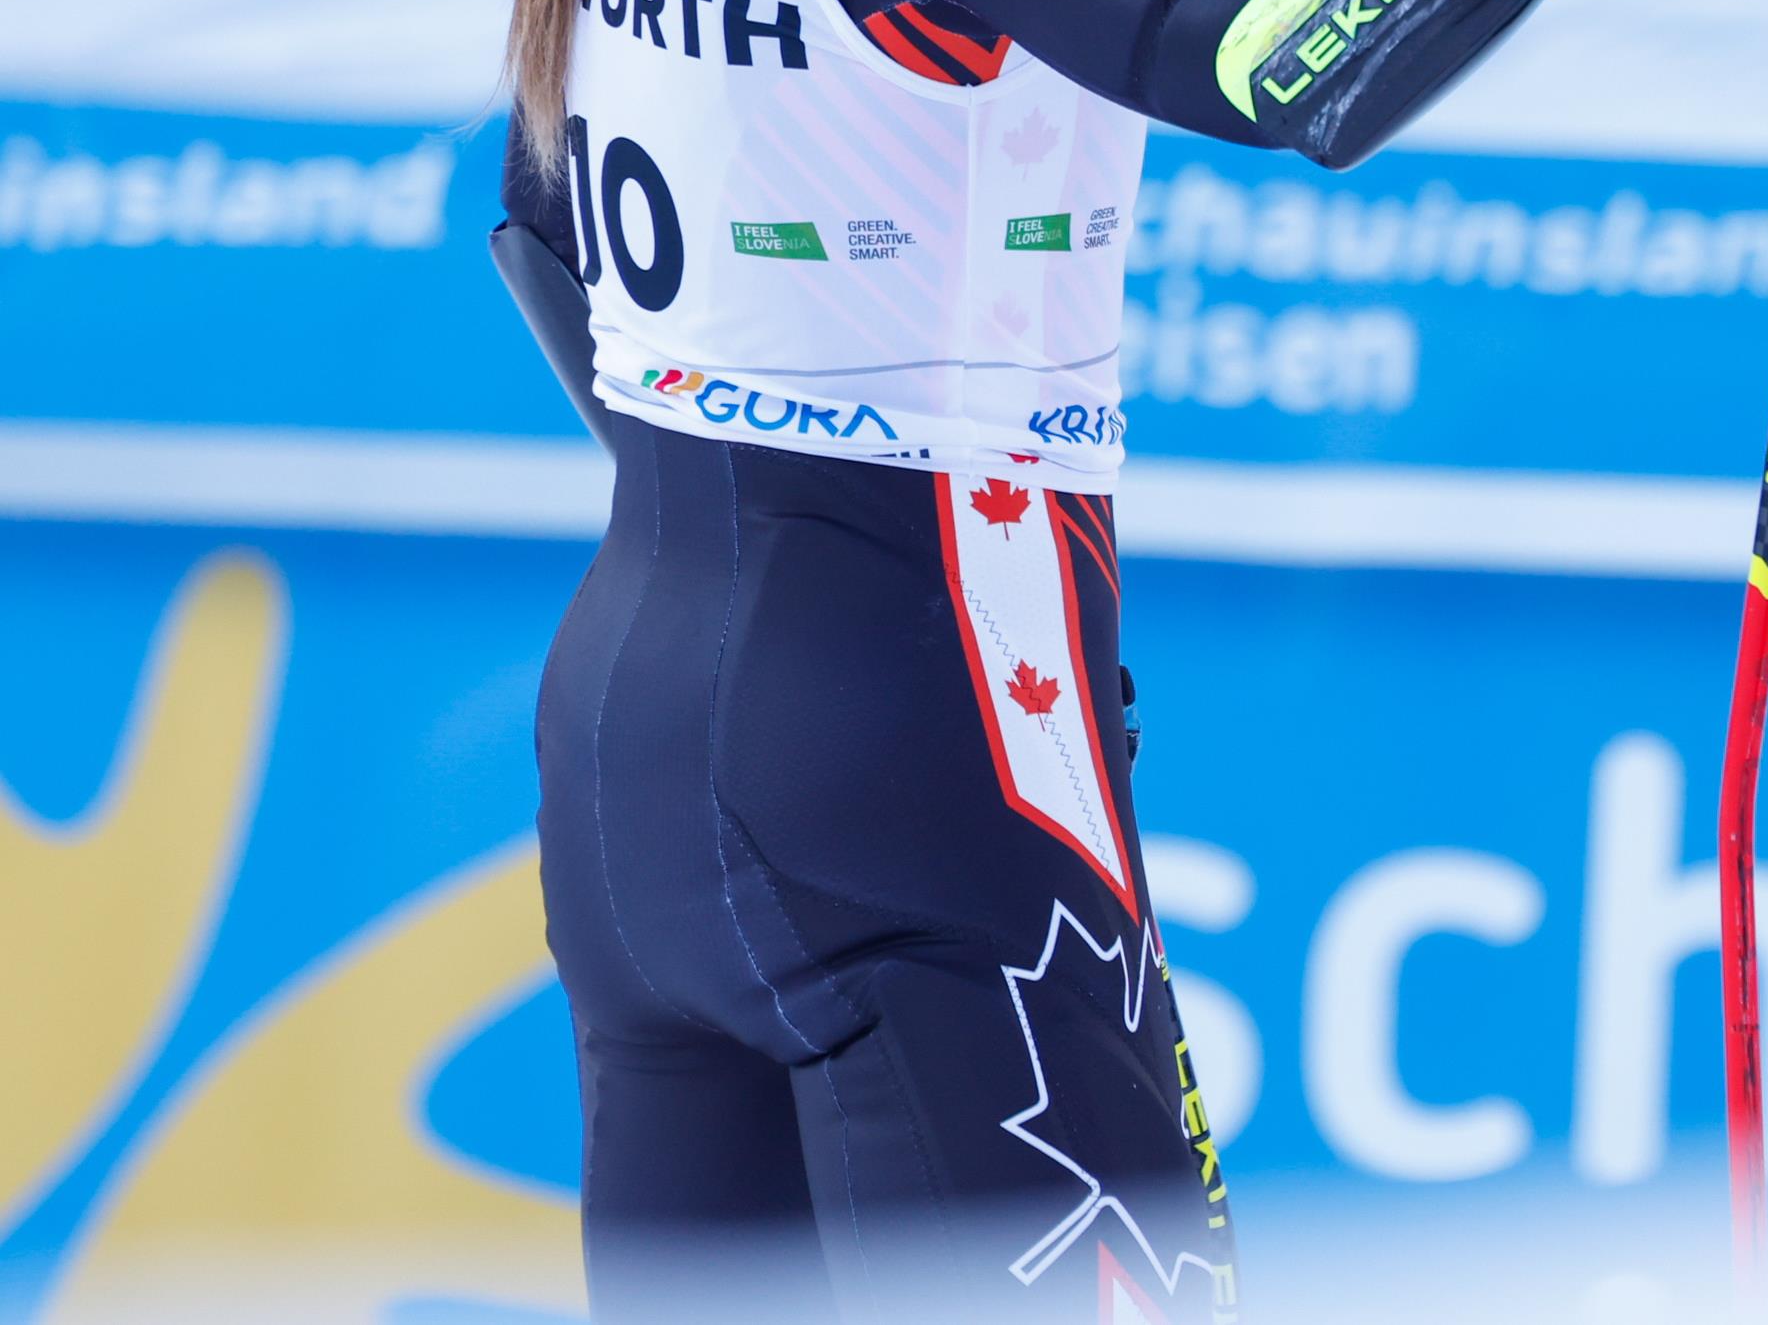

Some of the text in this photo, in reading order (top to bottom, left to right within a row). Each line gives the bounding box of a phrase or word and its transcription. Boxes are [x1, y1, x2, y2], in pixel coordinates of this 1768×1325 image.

[744, 225, 779, 238] FEEL
[847, 219, 899, 232] GREEN.
[1017, 219, 1044, 232] FEEL
[737, 237, 811, 251] SLOVENIA
[848, 233, 917, 246] CREATIVE.
[849, 247, 900, 261] SMART.
[1174, 1037, 1227, 1203] LEKI
